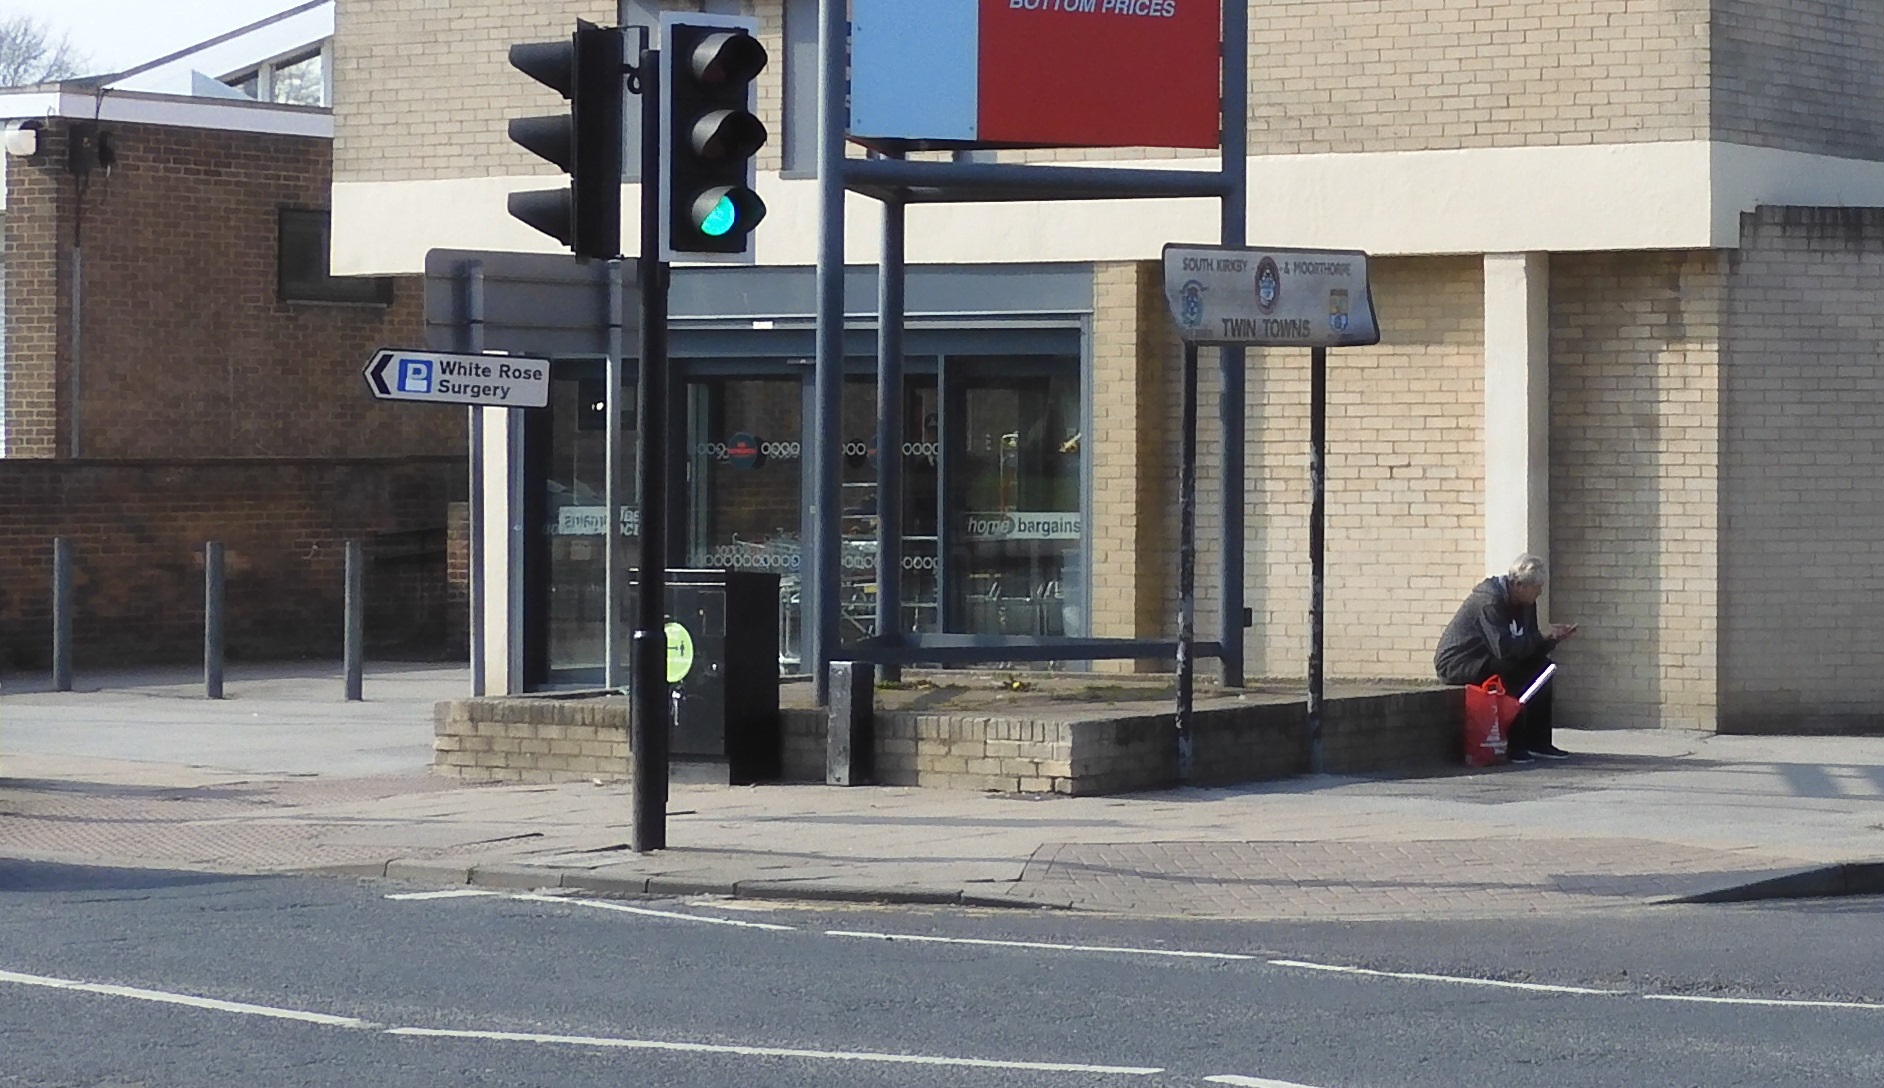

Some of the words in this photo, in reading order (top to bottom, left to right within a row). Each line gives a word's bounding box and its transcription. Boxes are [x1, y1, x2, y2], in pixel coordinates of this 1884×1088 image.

[1182, 257, 1214, 272] SOUTH
[1221, 317, 1257, 338] TWIN
[1262, 318, 1311, 338] TOWNS
[439, 360, 492, 378] White
[498, 364, 543, 381] Rose
[437, 379, 511, 400] Surgery
[967, 516, 1011, 533] home
[1017, 517, 1081, 538] bargains
